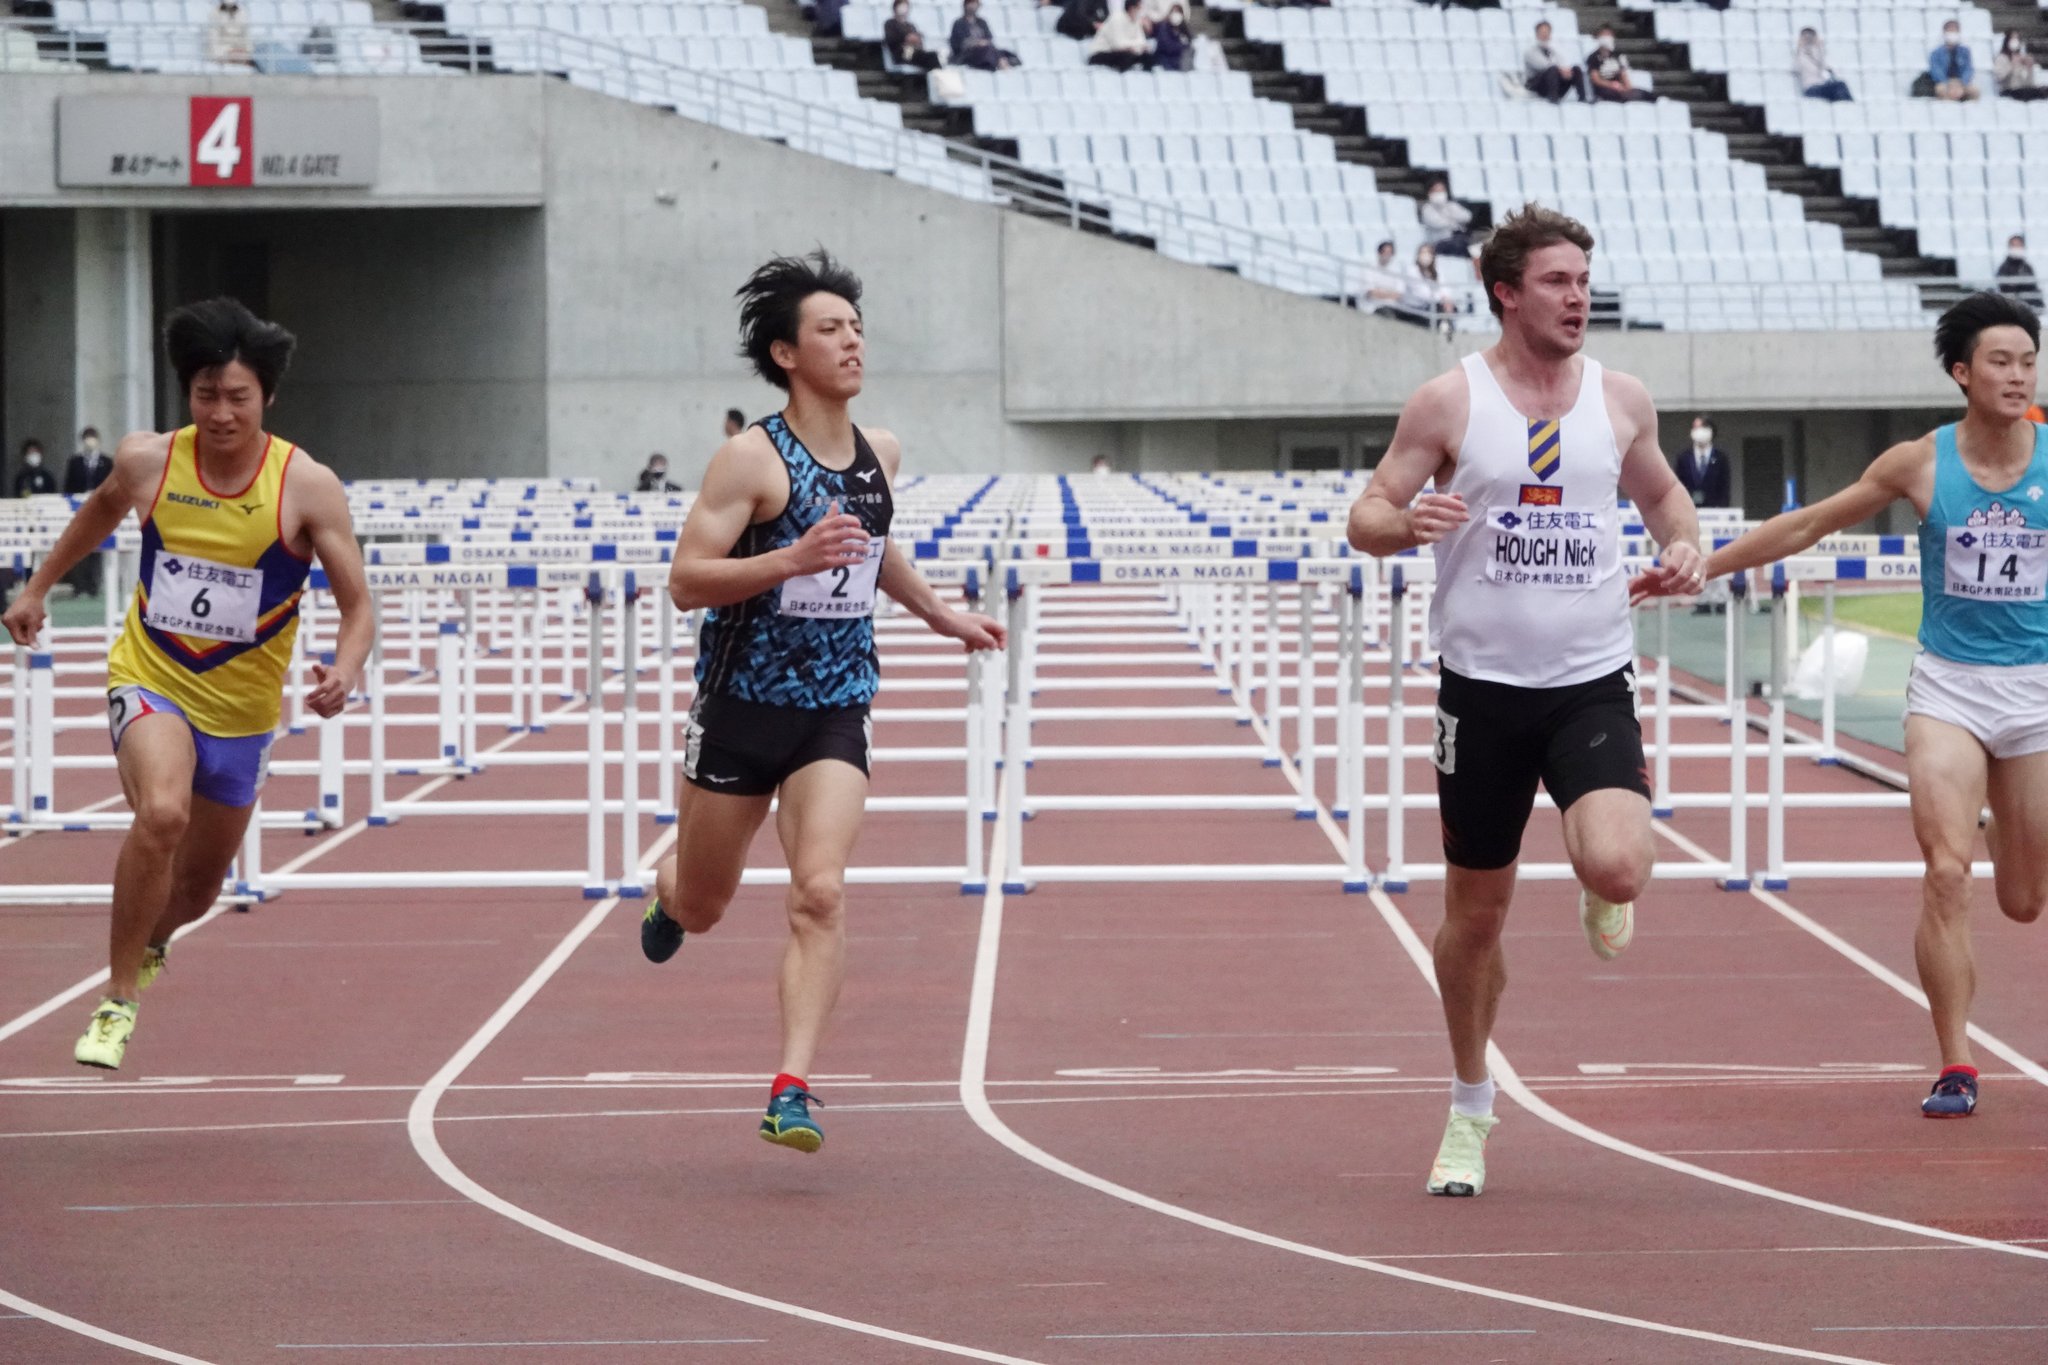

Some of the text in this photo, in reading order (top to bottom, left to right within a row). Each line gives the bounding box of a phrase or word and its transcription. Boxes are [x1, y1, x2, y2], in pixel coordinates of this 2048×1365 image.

[197, 102, 241, 178] 4
[303, 154, 340, 176] GATE
[167, 492, 220, 509] SUZUKI
[1527, 511, 1597, 530] 住友電工
[1711, 527, 1748, 536] NAGA
[1817, 542, 1868, 552] NAGAI
[1983, 532, 2047, 549] 住友電工
[462, 548, 518, 559] OSAKA
[529, 547, 579, 558] NAGAI
[1103, 545, 1158, 555] OSAKA
[1170, 545, 1221, 554] NAGAI
[1495, 536, 1597, 567] HOUGH Nick
[187, 561, 254, 589] 住友電工
[1115, 566, 1181, 579] OSAKA
[1193, 566, 1254, 578] NAGAI
[1880, 564, 1919, 575] OSA
[1977, 553, 2018, 583] 14
[369, 570, 420, 585] SAKA
[433, 569, 494, 584] NAGAI
[831, 565, 850, 598] 2
[191, 587, 211, 618] 6
